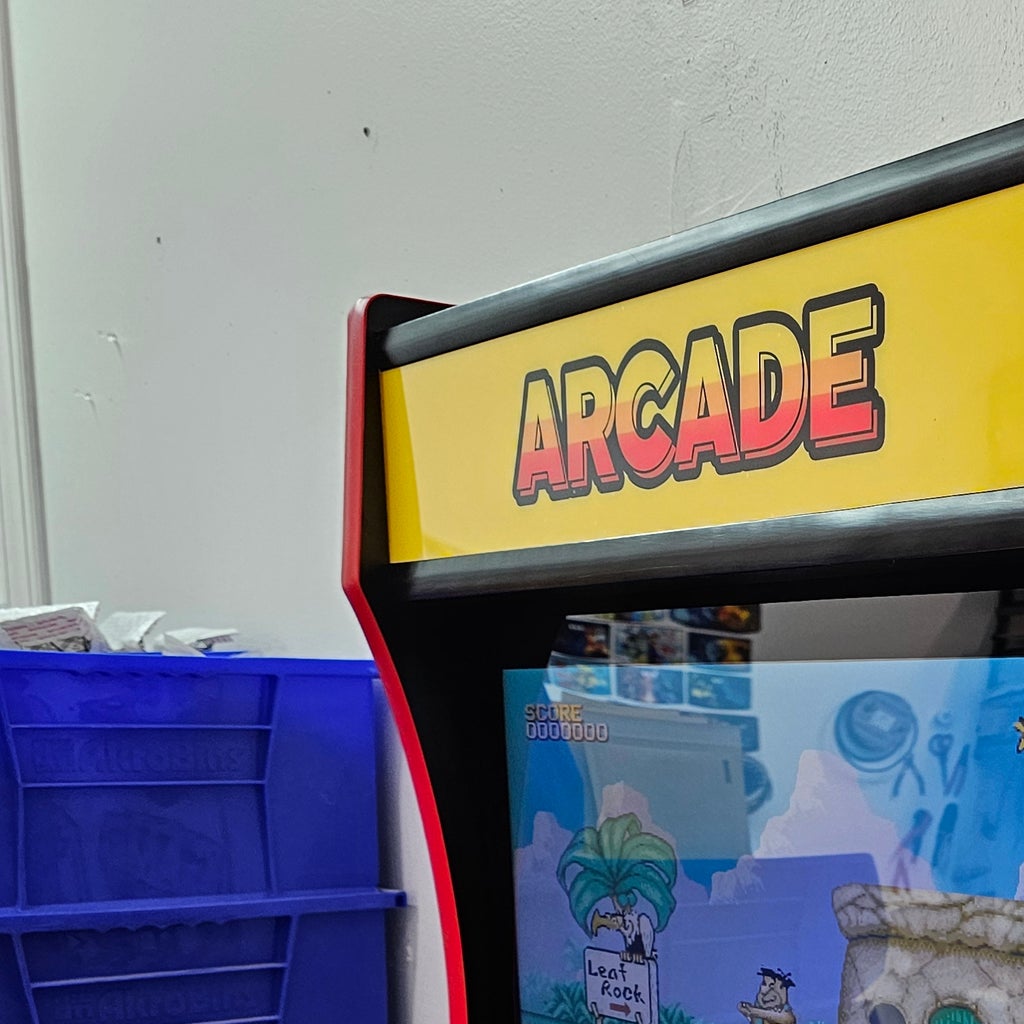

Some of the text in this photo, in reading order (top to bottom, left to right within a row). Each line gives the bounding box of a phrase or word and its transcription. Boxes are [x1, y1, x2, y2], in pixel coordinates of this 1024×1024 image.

[514, 284, 884, 505] ARCADE
[525, 703, 583, 722] SCORE
[526, 722, 609, 743] 0000000
[601, 980, 645, 1004] Rock
